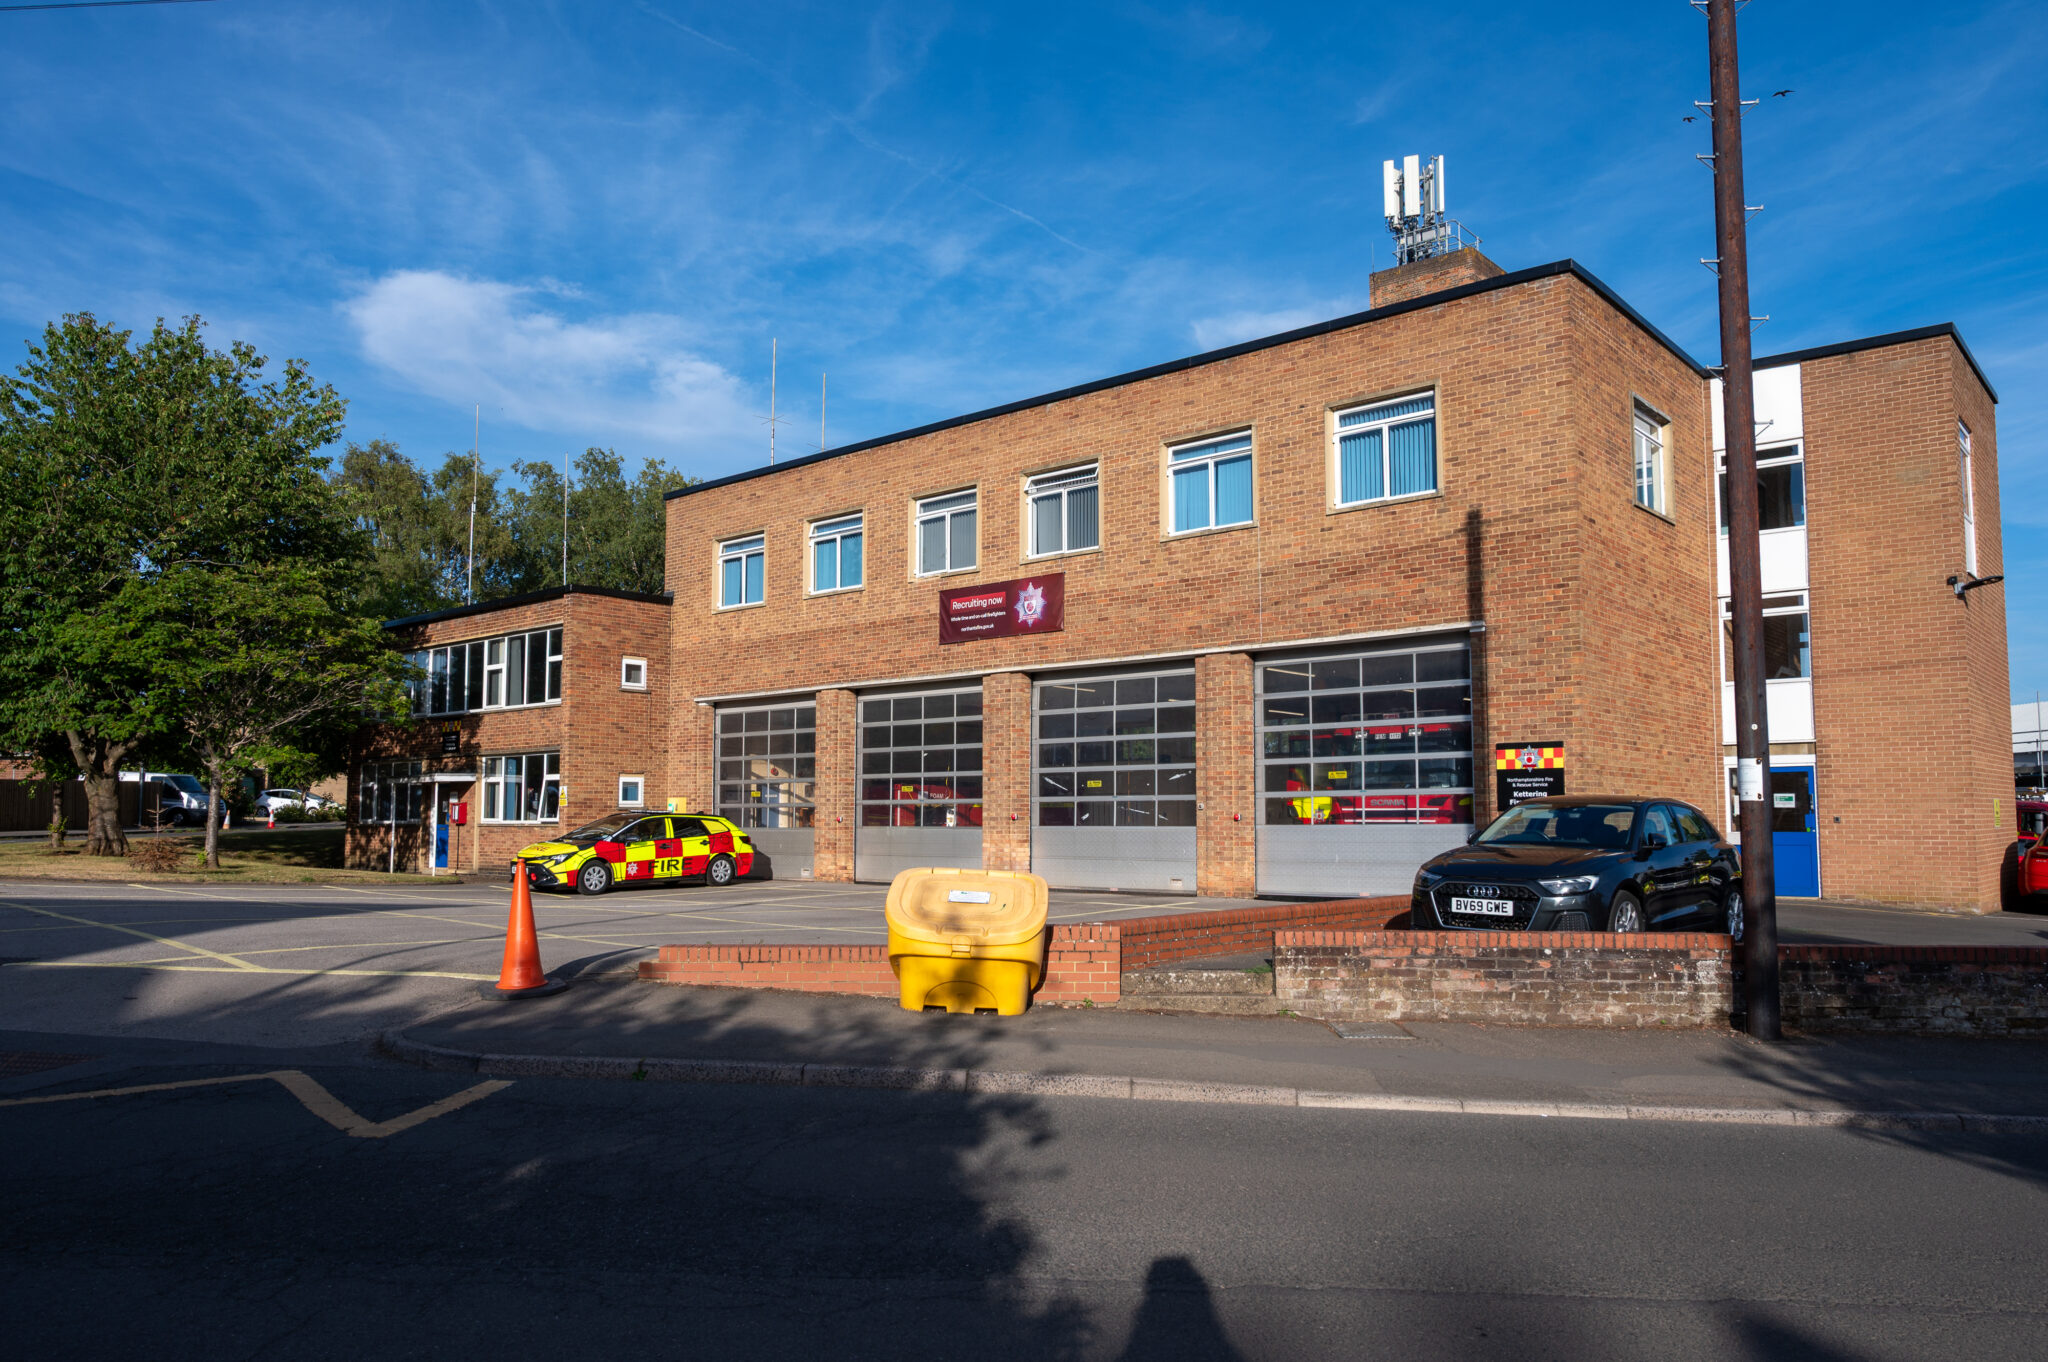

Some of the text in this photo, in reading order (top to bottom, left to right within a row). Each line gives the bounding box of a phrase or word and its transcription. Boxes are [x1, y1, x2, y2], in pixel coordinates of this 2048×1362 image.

[952, 597, 1003, 610] Recruiting now
[648, 858, 692, 873] FIRE
[1455, 899, 1508, 913] BV69 GWE
